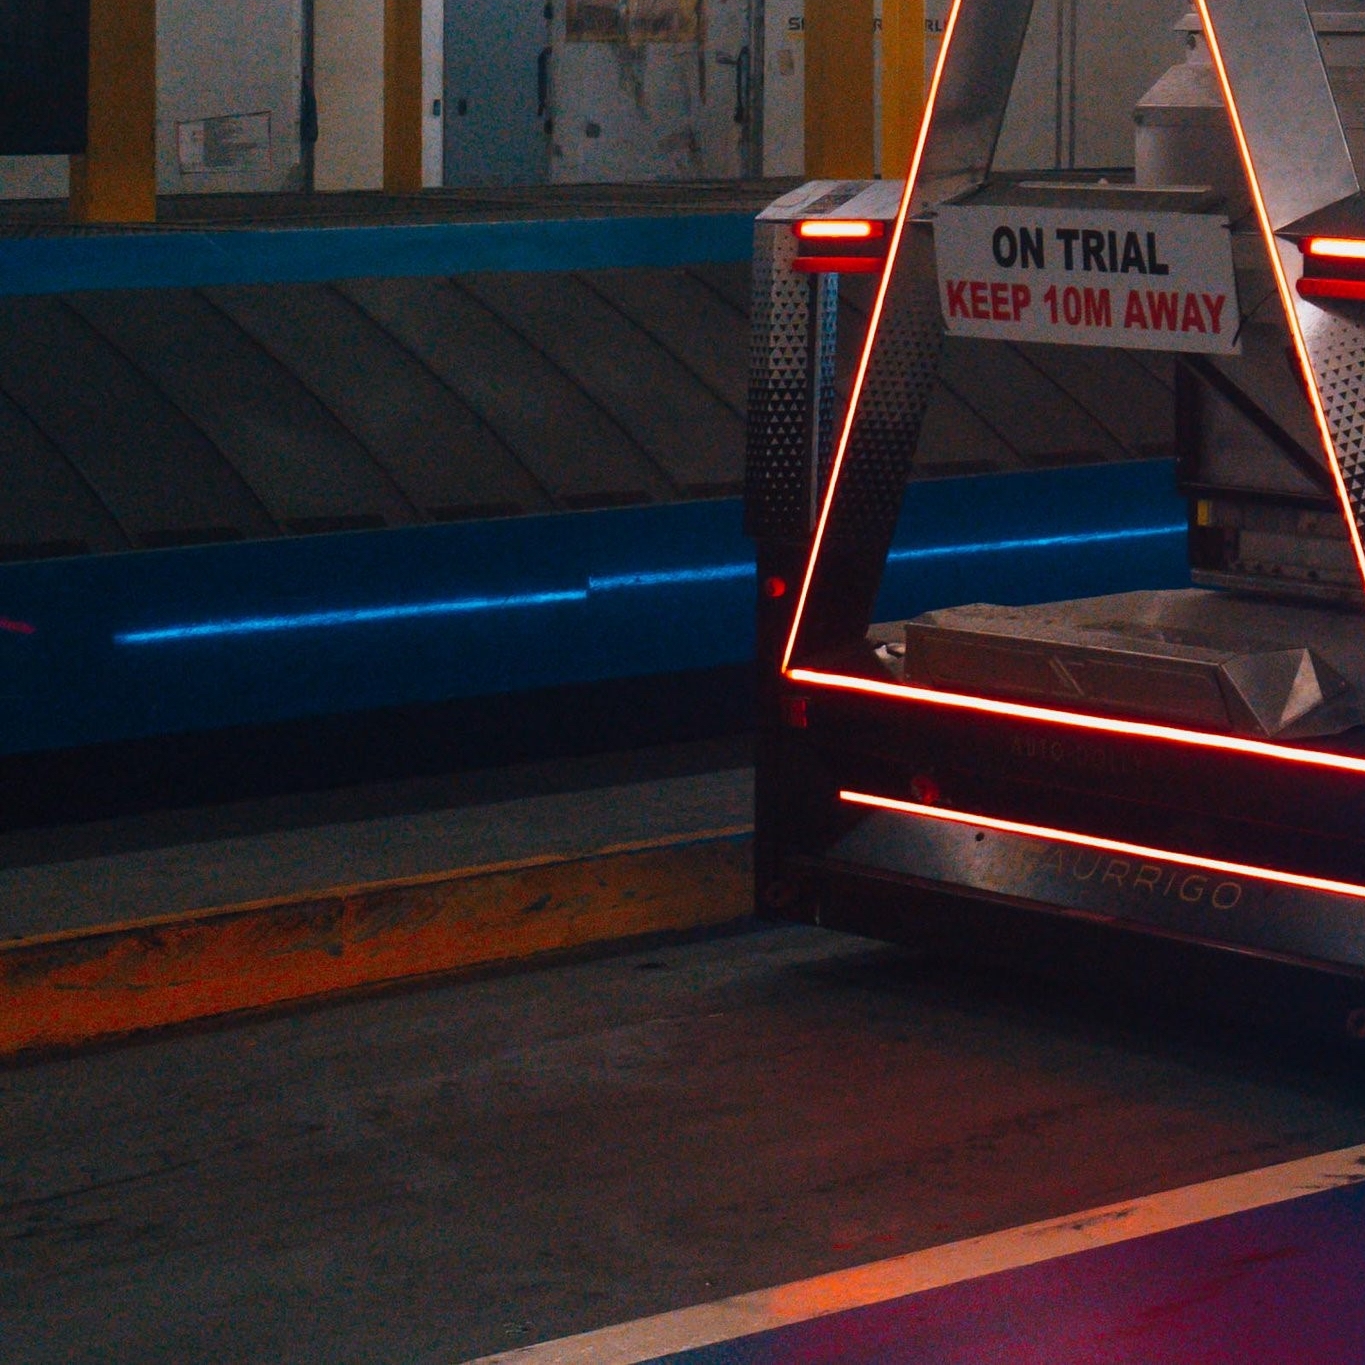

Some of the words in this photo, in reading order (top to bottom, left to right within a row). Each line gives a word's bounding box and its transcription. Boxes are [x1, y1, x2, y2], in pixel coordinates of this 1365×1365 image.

[992, 225, 1045, 269] ON
[1055, 228, 1169, 275] TRIAL
[945, 279, 1031, 322] KEEP
[1043, 284, 1113, 328] 10M
[1124, 289, 1226, 334] AWAY
[1038, 848, 1244, 911] AURRIGO
